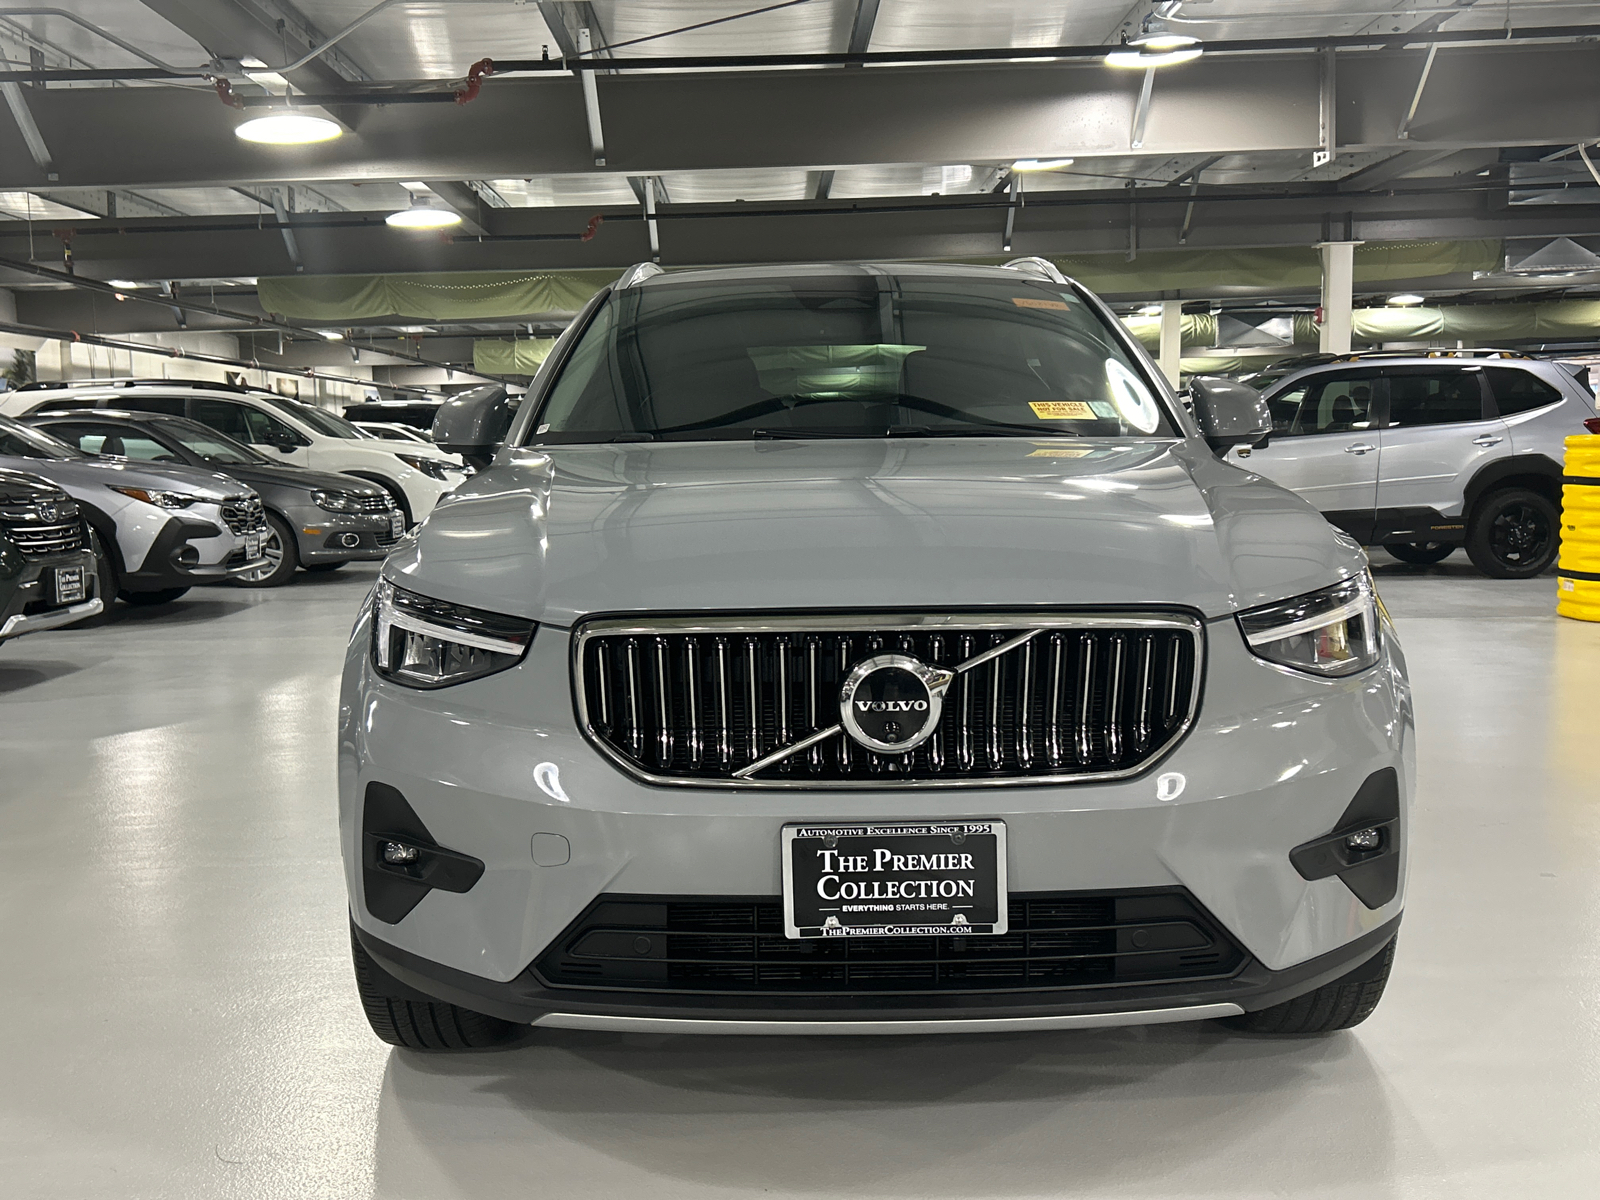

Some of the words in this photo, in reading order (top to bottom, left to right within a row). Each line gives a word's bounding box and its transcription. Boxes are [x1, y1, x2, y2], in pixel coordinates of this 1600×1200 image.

[855, 700, 928, 712] VOLVO
[798, 828, 864, 837] AUTOMOTIVE
[867, 826, 928, 836] EXCELLENCE
[930, 825, 960, 834] SINCE
[963, 824, 991, 833] 1995
[816, 849, 869, 873] THE
[873, 848, 975, 872] PREMIER
[816, 874, 976, 901] COLLECTION
[842, 904, 895, 913] EVERYTHING
[895, 903, 926, 911] STARTS
[926, 903, 950, 911] HERE.
